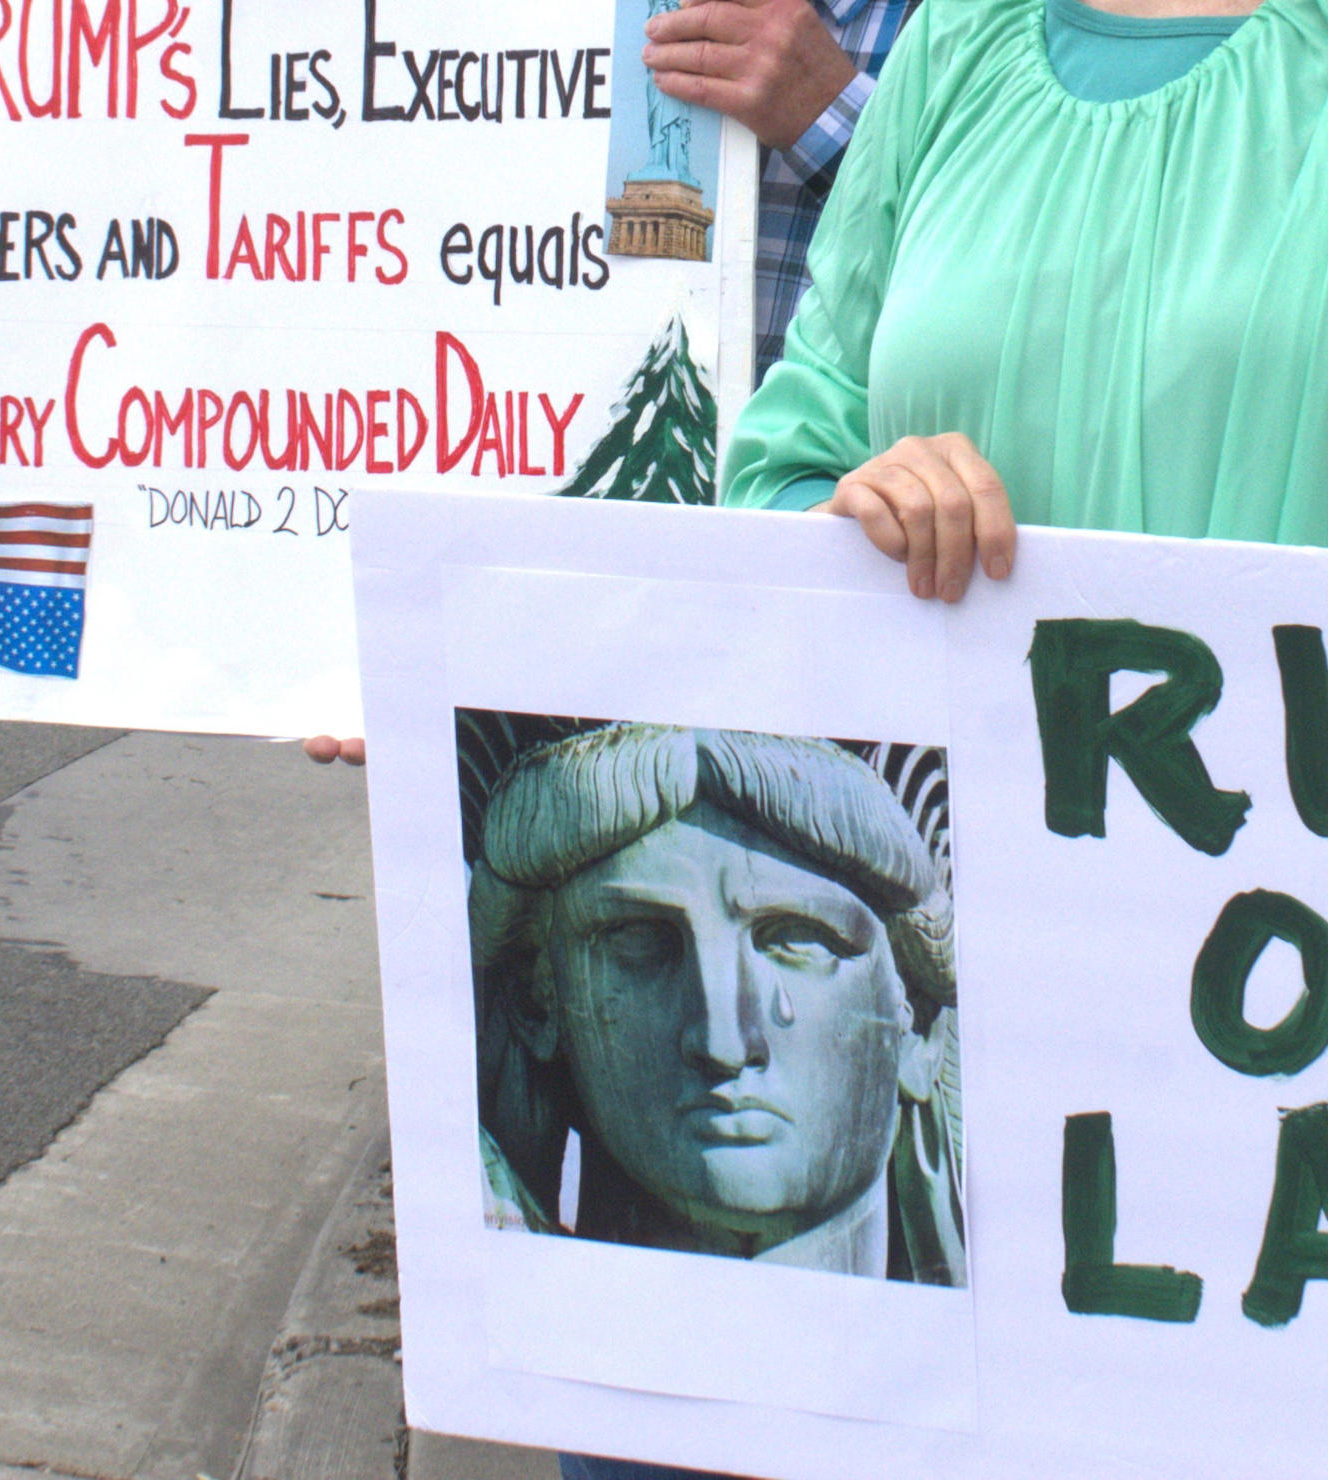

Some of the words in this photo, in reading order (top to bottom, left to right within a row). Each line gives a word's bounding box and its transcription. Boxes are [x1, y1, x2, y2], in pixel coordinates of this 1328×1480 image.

[97, 217, 179, 280] AND
[184, 133, 408, 286] TARIFFS
[440, 210, 610, 305] equals
[64, 322, 428, 476] COMPOUNDED
[435, 330, 584, 479] DAILY
[273, 486, 299, 536] 2
